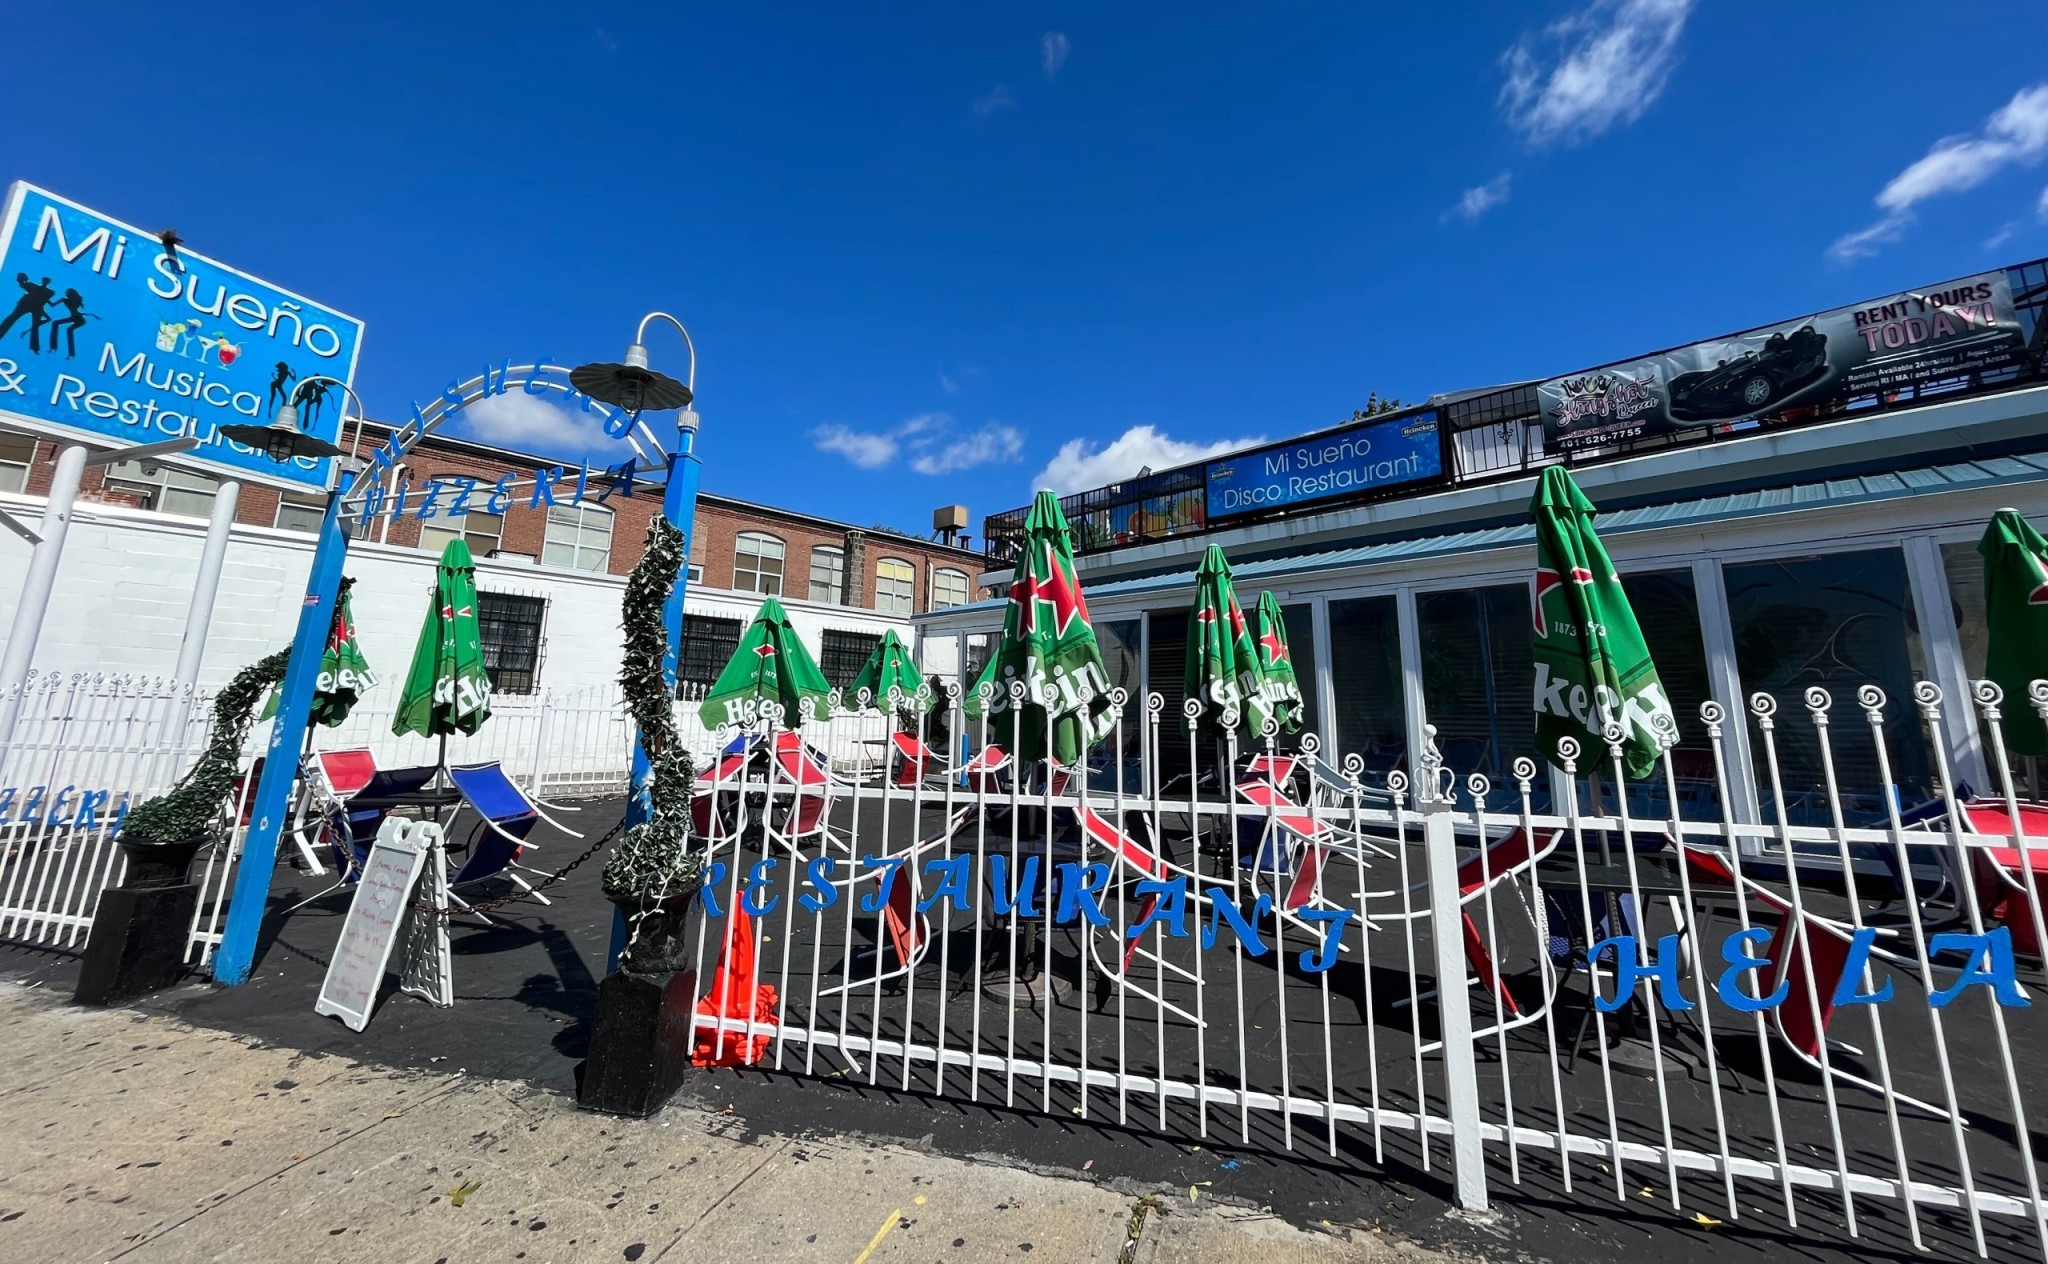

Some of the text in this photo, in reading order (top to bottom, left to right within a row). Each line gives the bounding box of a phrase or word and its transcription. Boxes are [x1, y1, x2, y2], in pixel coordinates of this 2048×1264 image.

[32, 204, 342, 358] Mi Sueño
[1854, 282, 1993, 327] RENT YOURS
[1858, 302, 1998, 352] TODAY!
[97, 341, 262, 417] Musica
[1850, 379, 1880, 391] Serving
[1881, 377, 1889, 385] RI
[1896, 373, 1909, 382] MA
[1915, 369, 1930, 378] and
[1931, 360, 1984, 376] Surrounding
[1878, 364, 1914, 376] Available
[1403, 423, 1435, 436] Heineken
[1560, 427, 1642, 448] 401-626-7755
[1265, 438, 1371, 476] Mi Sueño
[1224, 450, 1419, 509] Disco Restaurant
[1554, 621, 1577, 637] 1873
[699, 853, 1355, 973] RESTAURANT
